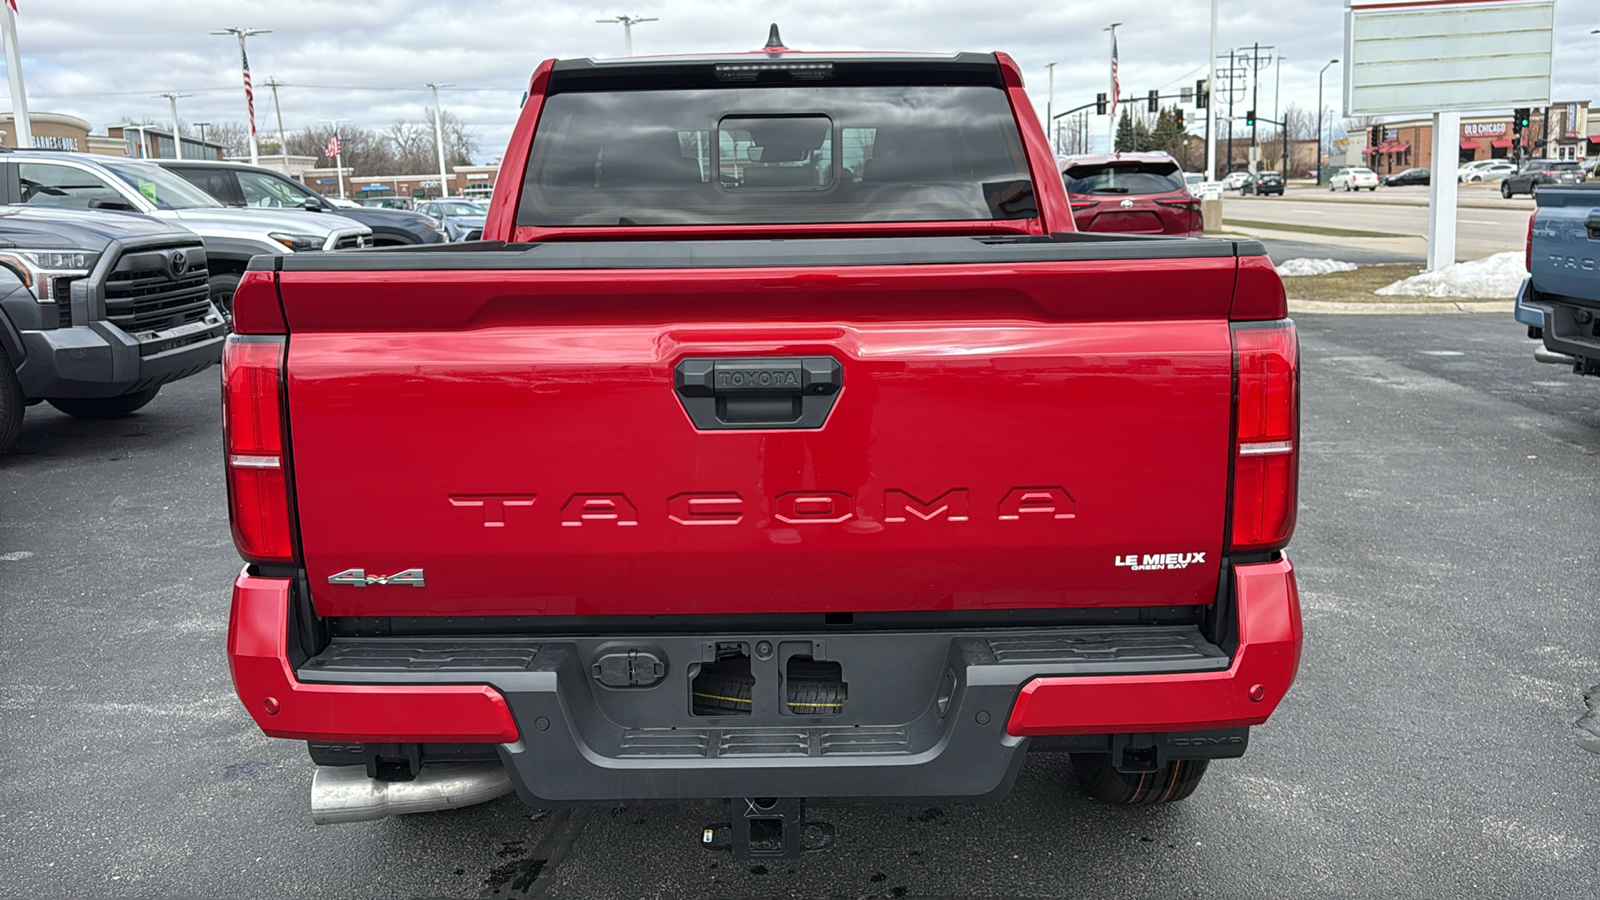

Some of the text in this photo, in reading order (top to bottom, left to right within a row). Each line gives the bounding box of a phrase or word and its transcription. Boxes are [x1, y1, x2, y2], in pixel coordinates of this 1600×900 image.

[1464, 122, 1506, 135] OLD CHICAGO
[32, 136, 57, 149] BARNES
[62, 138, 78, 151] NOBLE
[1549, 254, 1600, 272] TAC
[718, 371, 799, 386] TOYOTA
[448, 485, 1077, 528] TACOMA
[1115, 552, 1206, 566] LE MIEUX
[327, 567, 426, 587] 4x4
